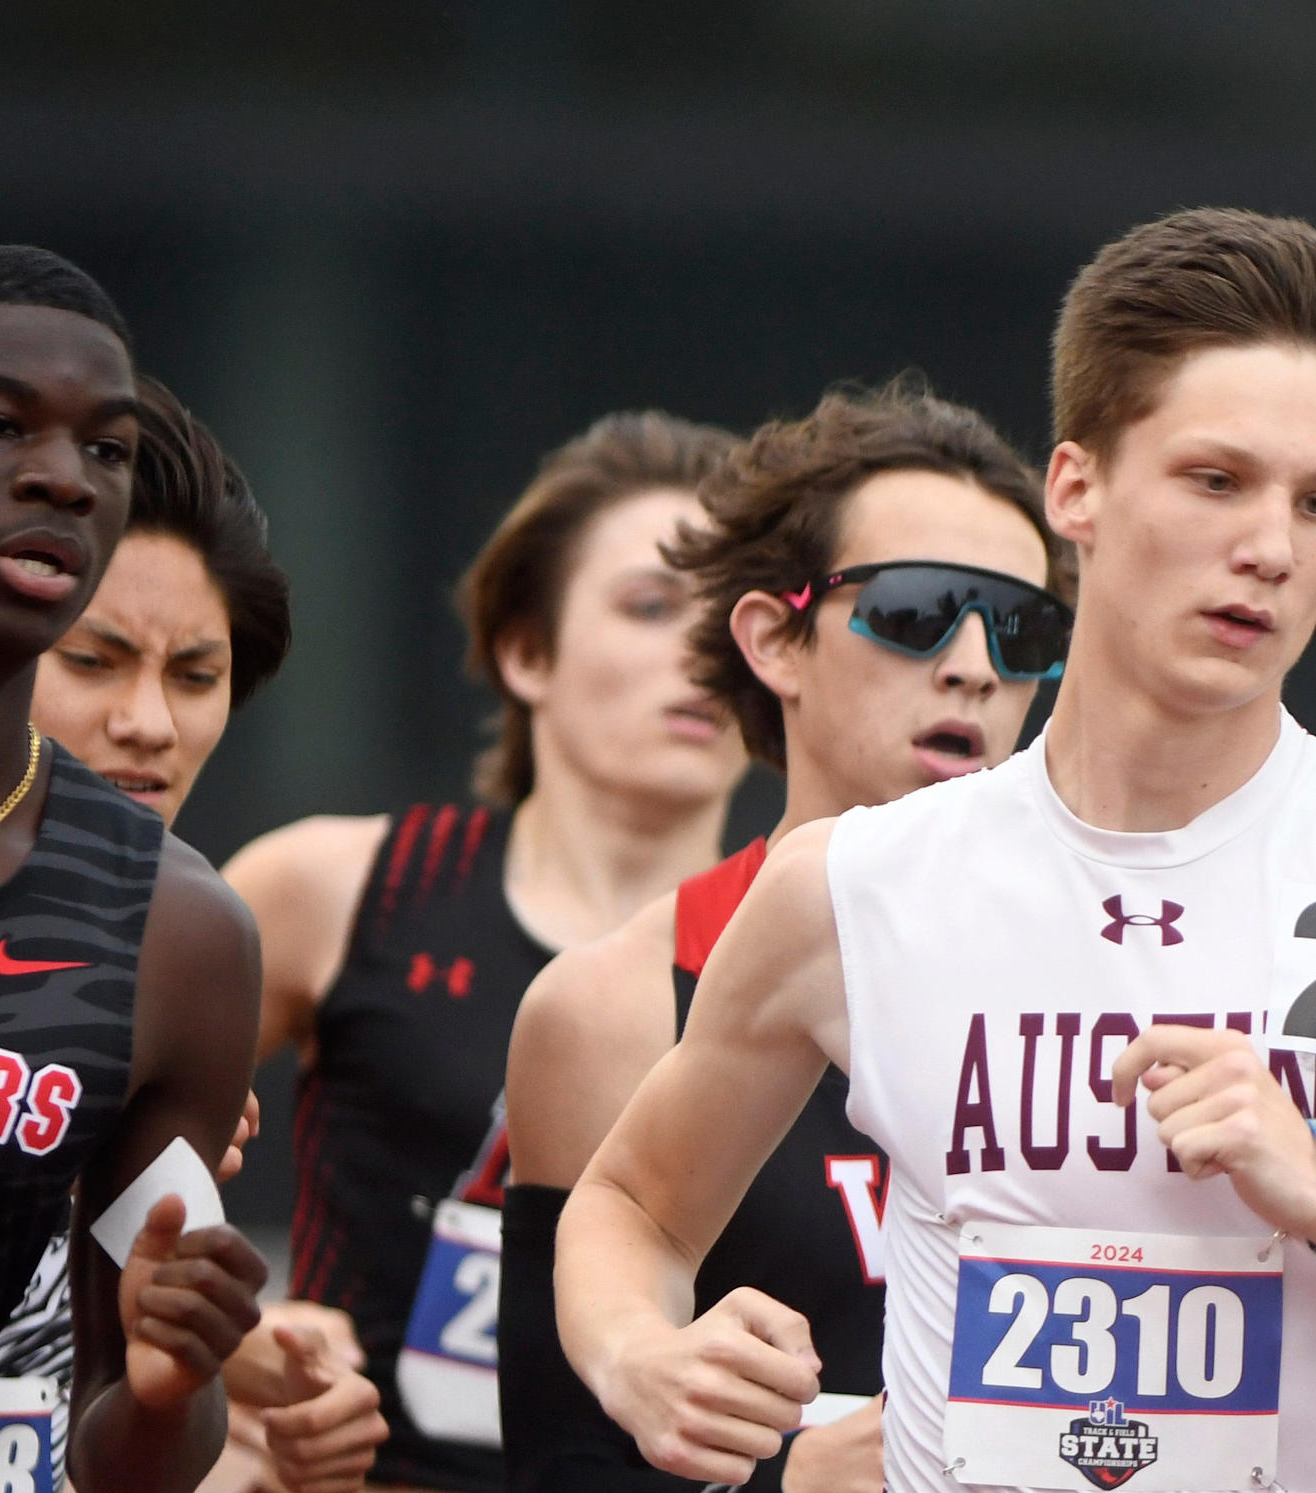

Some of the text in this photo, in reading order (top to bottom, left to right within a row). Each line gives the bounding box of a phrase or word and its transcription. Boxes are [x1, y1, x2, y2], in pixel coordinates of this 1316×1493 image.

[1090, 1244, 1144, 1263] 2024
[982, 1273, 1245, 1399] 2310
[1083, 1427, 1105, 1436] TRACK
[1061, 1434, 1157, 1461] STATE
